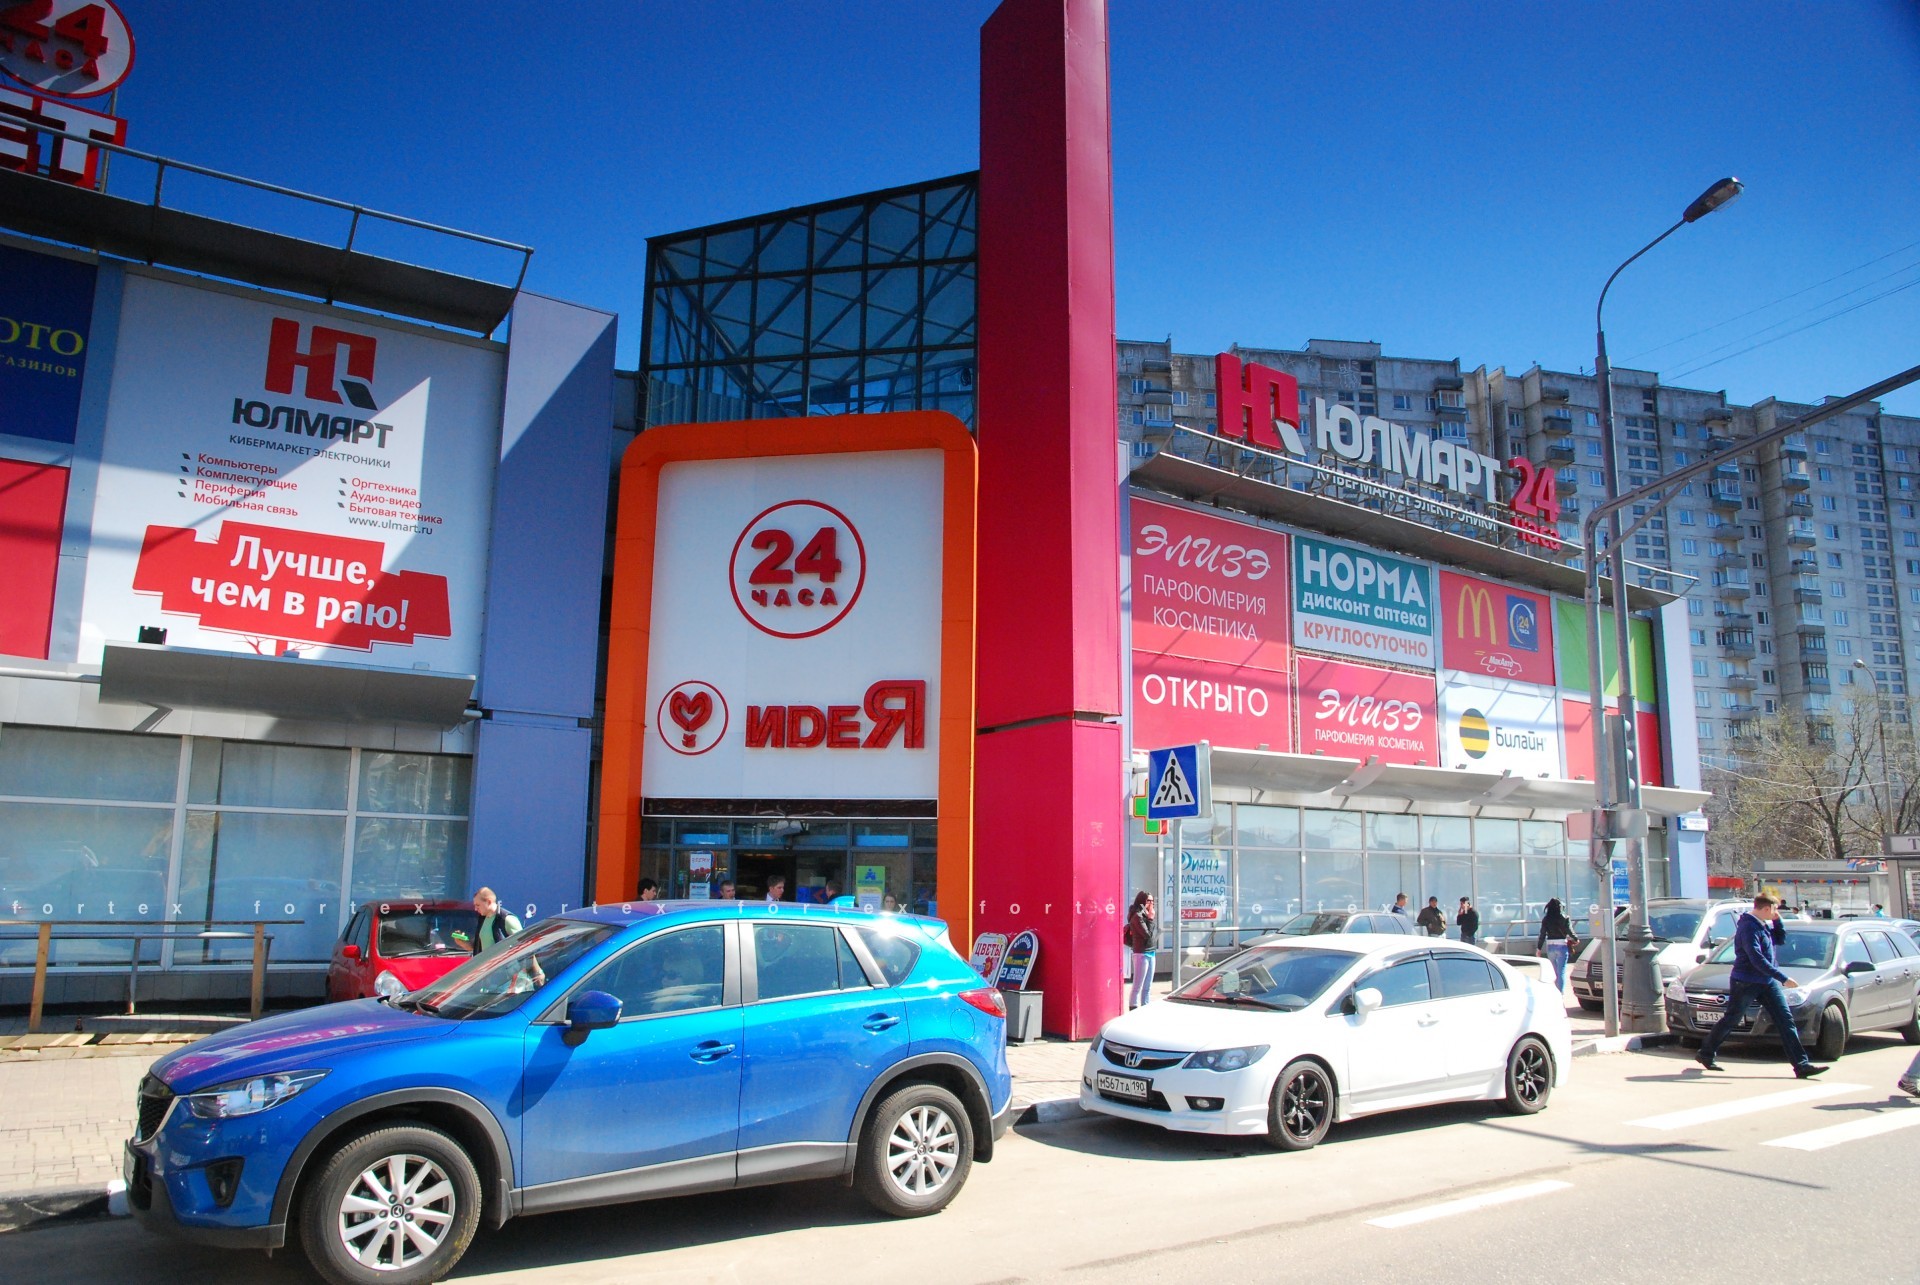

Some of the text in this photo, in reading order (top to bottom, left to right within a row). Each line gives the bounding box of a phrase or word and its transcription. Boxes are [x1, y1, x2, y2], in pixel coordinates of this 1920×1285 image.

[0, 0, 108, 58] 24
[0, 354, 77, 377] АЗИНОВ
[231, 397, 394, 449] ЮЛМАРТ
[198, 453, 278, 475] Компьютеры
[229, 434, 391, 469] КИБЕРМАРКЕТ ЭЛЕКТРОНИКИ
[1310, 396, 1501, 504] ЮЛМАРТ
[194, 479, 266, 499] Периферия
[196, 466, 298, 491] Комплектующие
[351, 477, 417, 496] Оргтехника
[1508, 456, 1561, 523] 24
[193, 493, 299, 517] Мобильная связь
[349, 503, 443, 525] Бытовая техника
[350, 490, 422, 509] Аудио-видео
[348, 515, 433, 535] www.ulmart.ru
[230, 534, 375, 591] Лучше,
[749, 527, 842, 584] 24
[1136, 524, 1271, 580] ЭЛИЗЭ
[1302, 544, 1426, 609] НОРМА
[191, 576, 409, 631] чем в раю!
[751, 588, 838, 607] ЧАСА
[1143, 574, 1266, 615] ПАРФЮМЕРИЯ
[1153, 606, 1258, 642] КОСМЕТИКА
[1302, 592, 1427, 628] дисконт аптека
[1518, 615, 1530, 629] 24
[1303, 621, 1428, 657] КРУГЛОСУТОЧНО
[1142, 674, 1268, 717] ОТКРЫТО
[1315, 688, 1423, 731] ЭЛИЗЭ
[1315, 728, 1424, 752] ПАРФЮМЕРИЯ КОСМЕТИКА
[1495, 726, 1544, 751] Билайн
[1167, 886, 1226, 896] ПАЧЕЧНАЯ
[1168, 875, 1226, 885] ХМЧИСТКА
[975, 943, 1002, 956] ЦВЕТЫ
